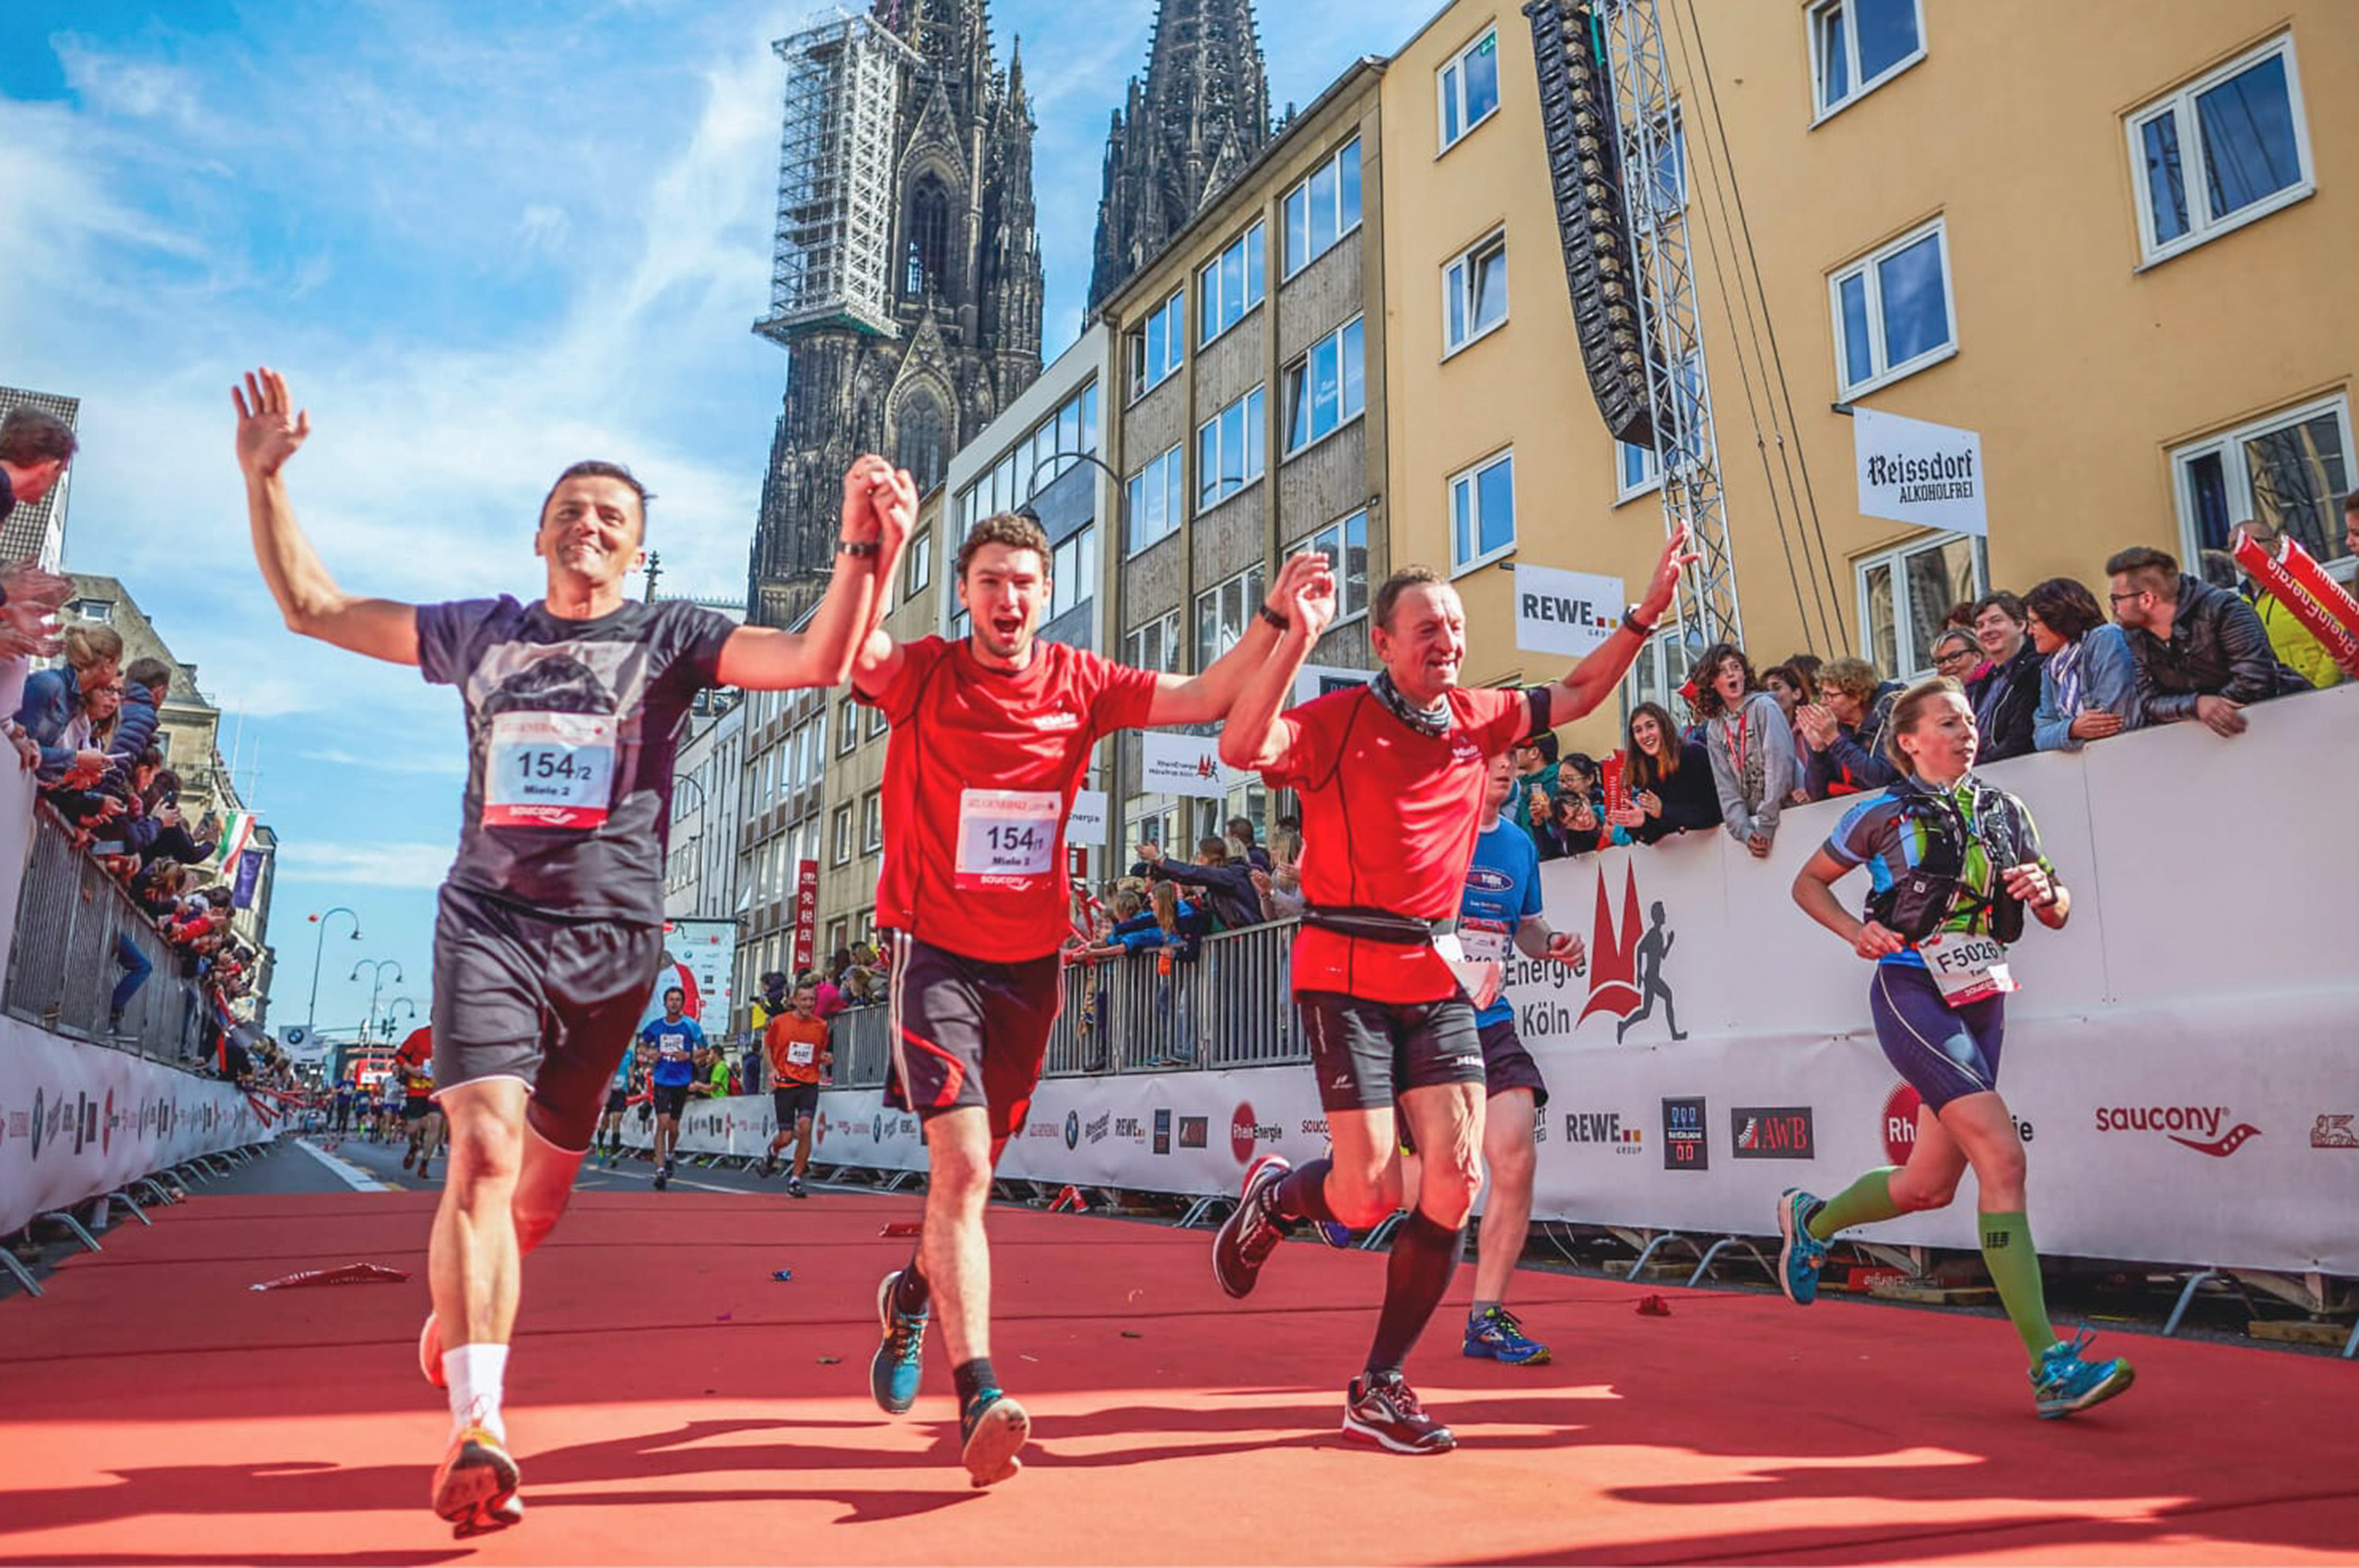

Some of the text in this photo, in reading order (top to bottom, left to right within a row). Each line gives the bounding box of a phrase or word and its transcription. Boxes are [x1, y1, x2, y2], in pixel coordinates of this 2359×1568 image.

[1867, 449, 1973, 486] Reissdorf
[1899, 481, 1974, 503] ALKOHOLFREI
[1522, 593, 1593, 626] REWE
[517, 751, 593, 780] 154/2
[560, 787, 570, 797] 2
[1936, 941, 1999, 974] F5026
[1522, 1000, 1570, 1036] Köln
[1234, 1123, 1283, 1142] RheinEnergie
[1301, 1118, 1331, 1133] sauco
[1566, 1113, 1621, 1142] REWE
[1762, 1117, 1808, 1151] AWB
[2095, 1106, 2222, 1138] saucony
